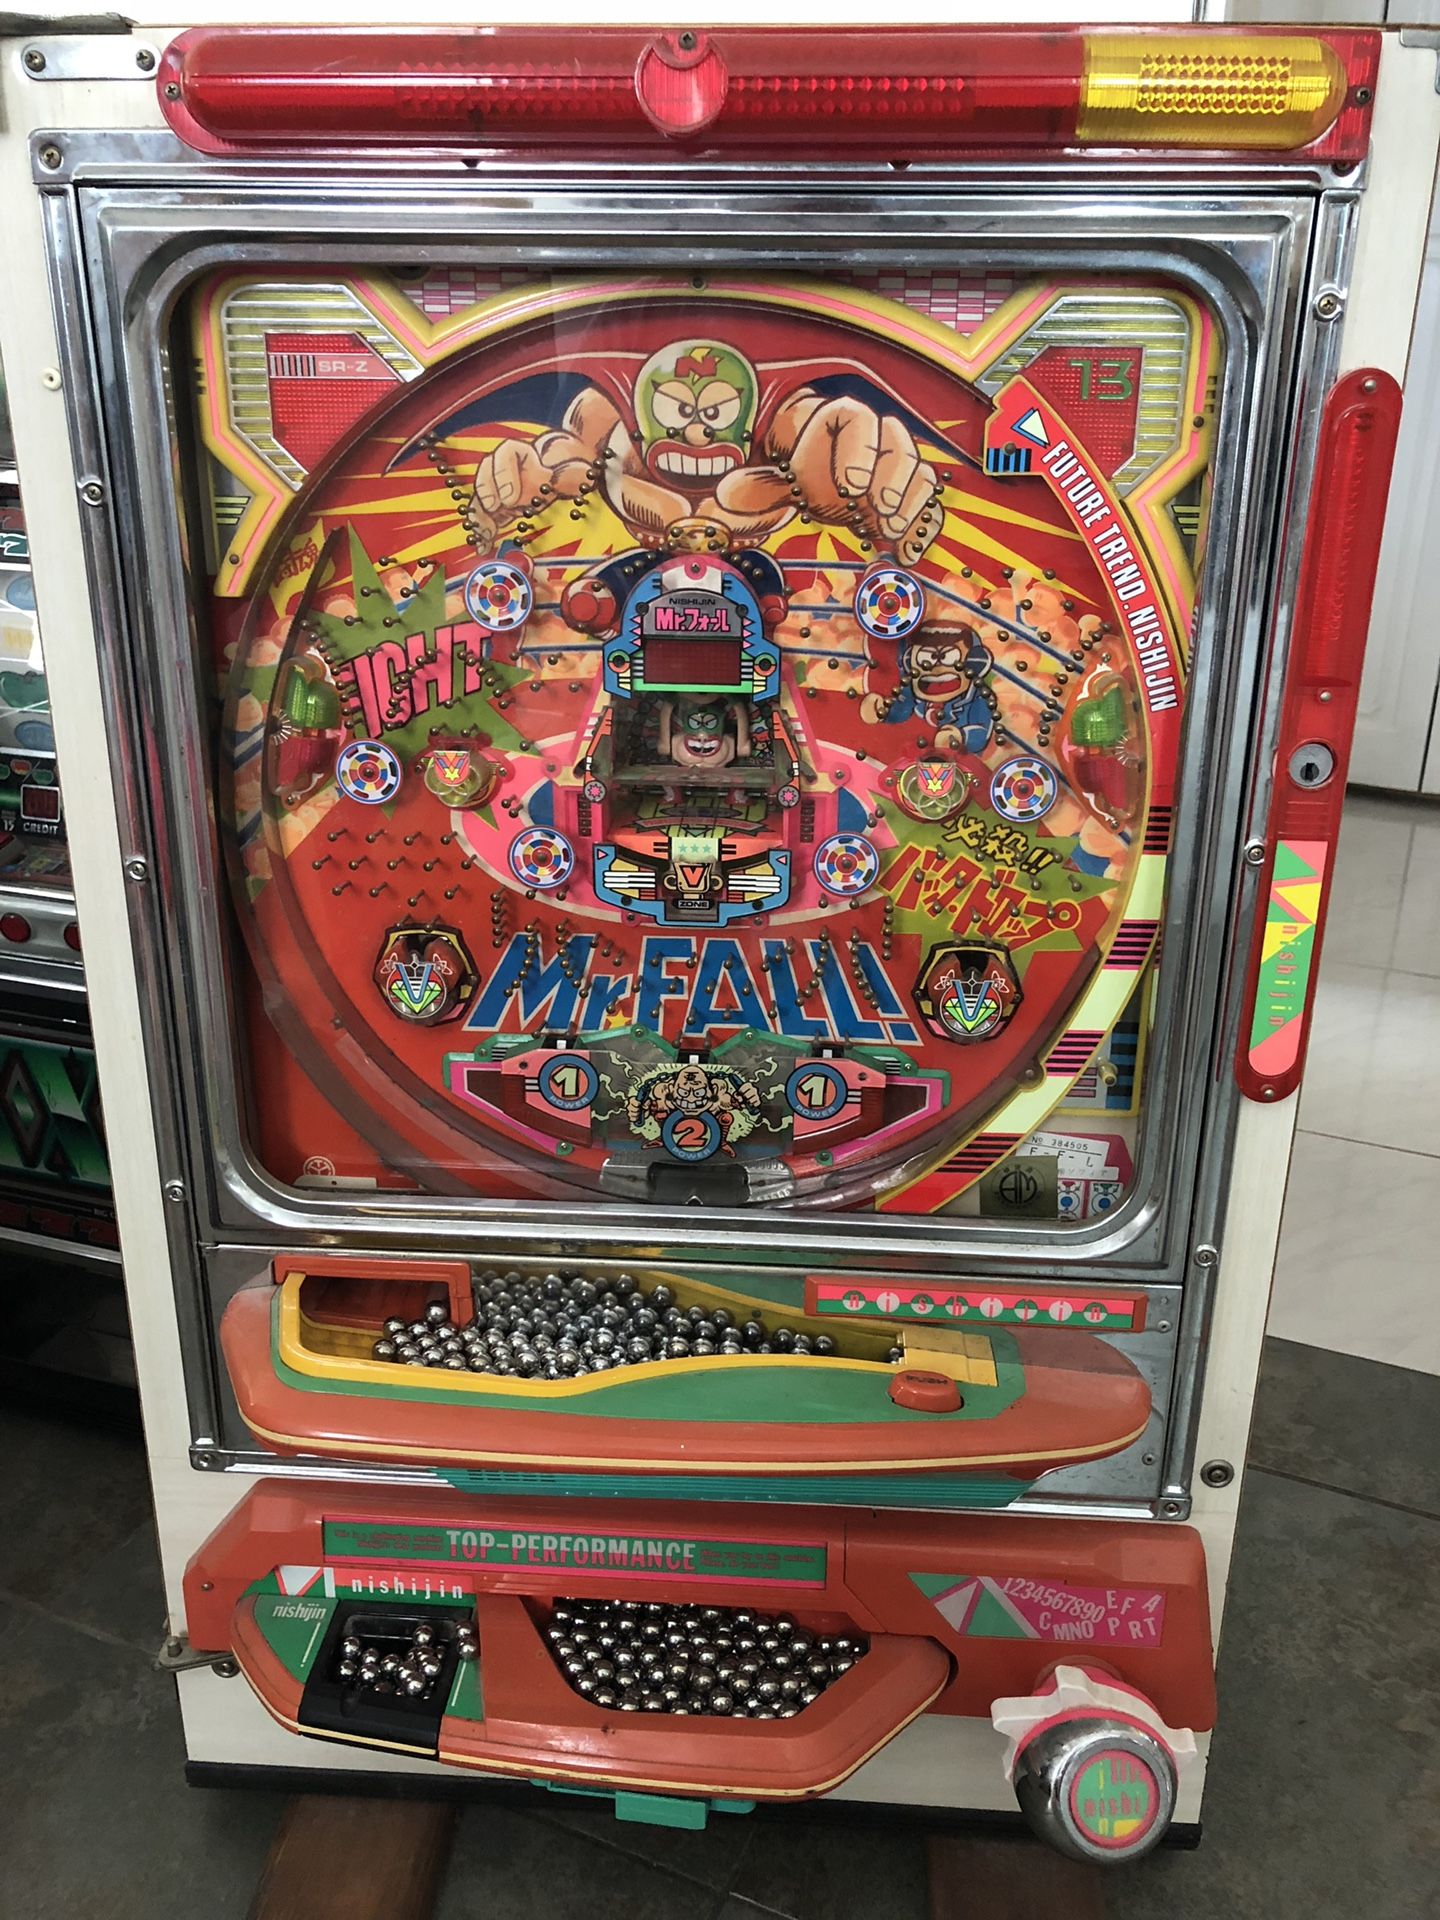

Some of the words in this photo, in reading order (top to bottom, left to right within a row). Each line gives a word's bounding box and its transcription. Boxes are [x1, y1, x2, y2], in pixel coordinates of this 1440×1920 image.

[318, 360, 369, 373] SR-Z
[1069, 359, 1134, 401] 13
[1041, 440, 1111, 529] FUTURE
[1127, 605, 1179, 713] NISHIJIN
[669, 597, 716, 606] NISHIJIN
[655, 607, 731, 633] Mr.フォール
[23, 822, 59, 835] CREDIT
[678, 900, 710, 909] ZONE
[1268, 924, 1301, 1028] nishijin
[553, 1065, 580, 1098] 1
[801, 1075, 829, 1107] 1
[549, 1095, 590, 1109] POWER
[795, 1104, 836, 1118] POWER
[673, 1118, 708, 1148] 2
[1051, 1138, 1089, 1151] 384505
[671, 1146, 711, 1160] POWER
[848, 1291, 1103, 1322] nishijin
[906, 1375, 948, 1385] PUSH
[446, 1530, 697, 1571] TOP-PERFORMANCE
[351, 1576, 463, 1600] nishijin
[1000, 1576, 1106, 1624] 1234567890
[272, 1601, 327, 1622] nishijin
[1106, 1590, 1118, 1609] E
[1120, 1597, 1135, 1615] F
